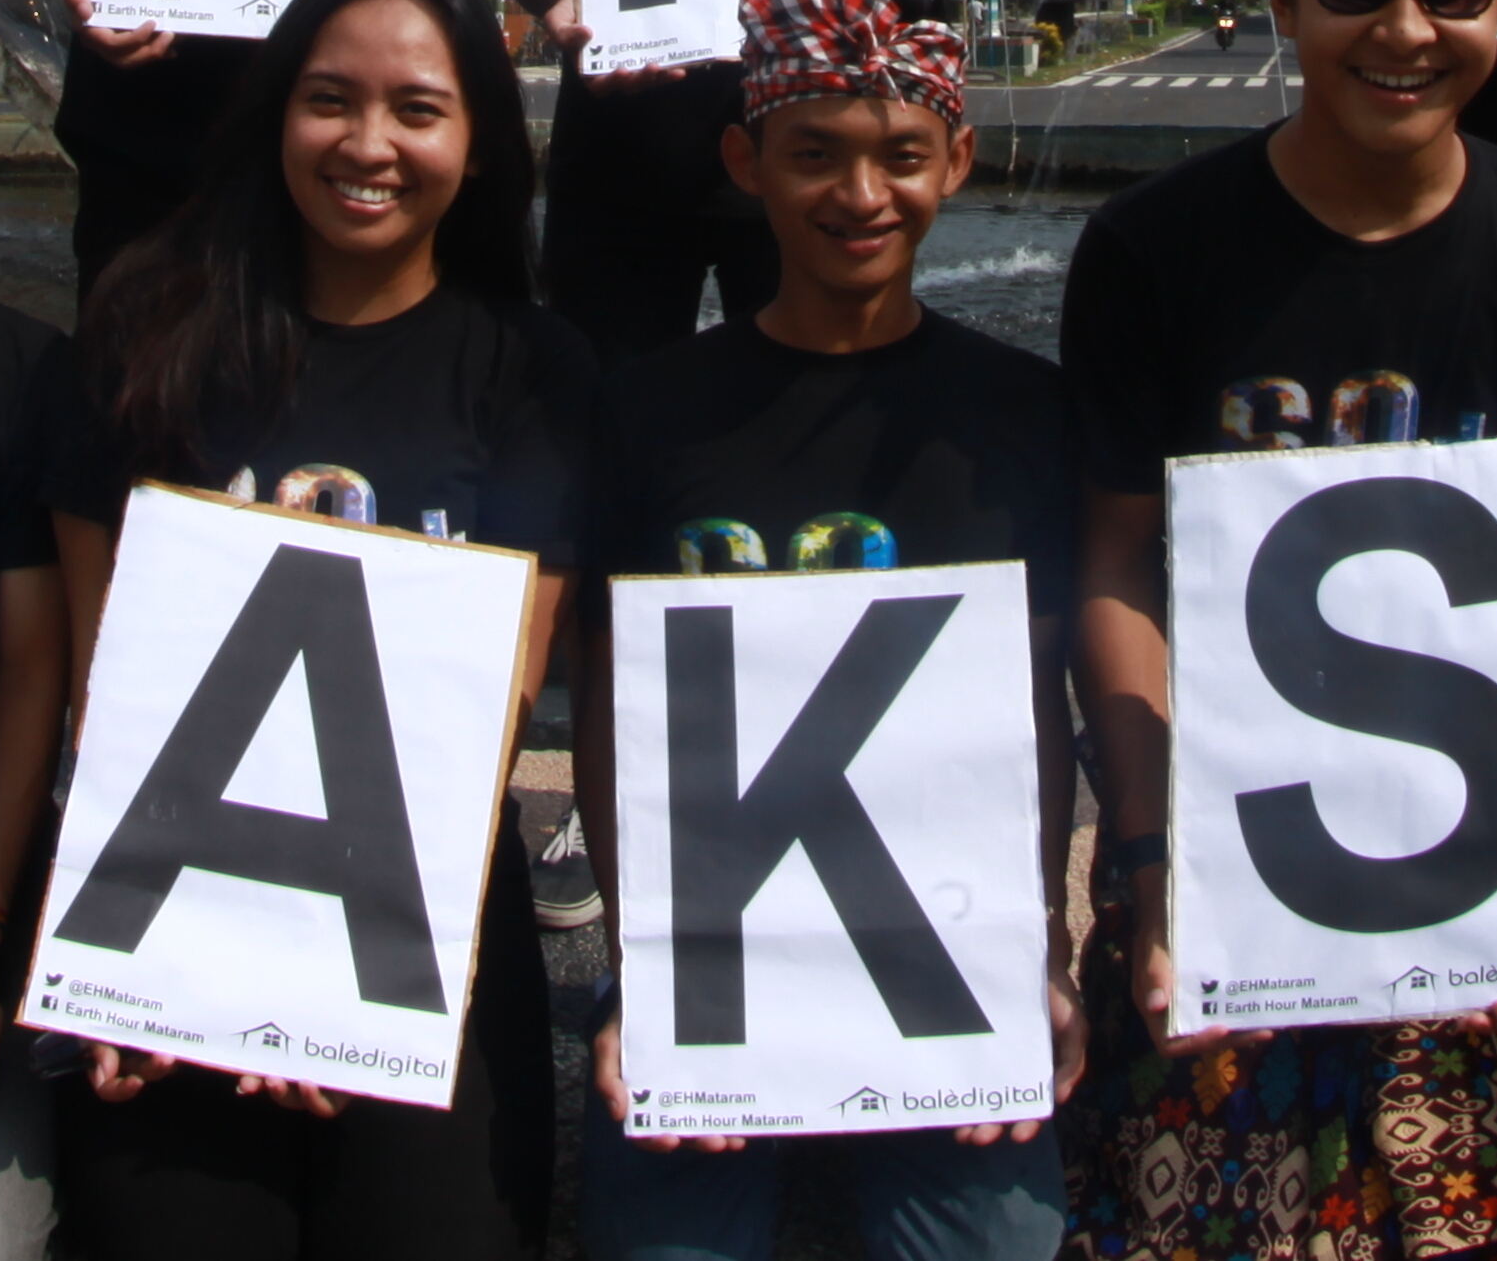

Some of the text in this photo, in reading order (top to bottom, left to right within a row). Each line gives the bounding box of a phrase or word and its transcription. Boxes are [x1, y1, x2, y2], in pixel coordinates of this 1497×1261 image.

[108, 3, 214, 21] Earth Hour Mataram
[608, 36, 678, 56] @EHMataram
[608, 47, 713, 70] Earth Hour Mataram
[53, 543, 448, 1015] A
[664, 594, 995, 1045] K
[68, 979, 164, 1012] @EHMataram
[1225, 976, 1316, 996] @EHMataram
[1225, 995, 1358, 1014] Earth Hour Mataram
[65, 1002, 205, 1044] Earth Hour Mataram
[304, 1036, 447, 1079] balèdigital
[658, 1091, 756, 1108] @EHMataram
[902, 1082, 1045, 1112] balèdigital
[659, 1113, 804, 1129] Earth Hour Mataram
